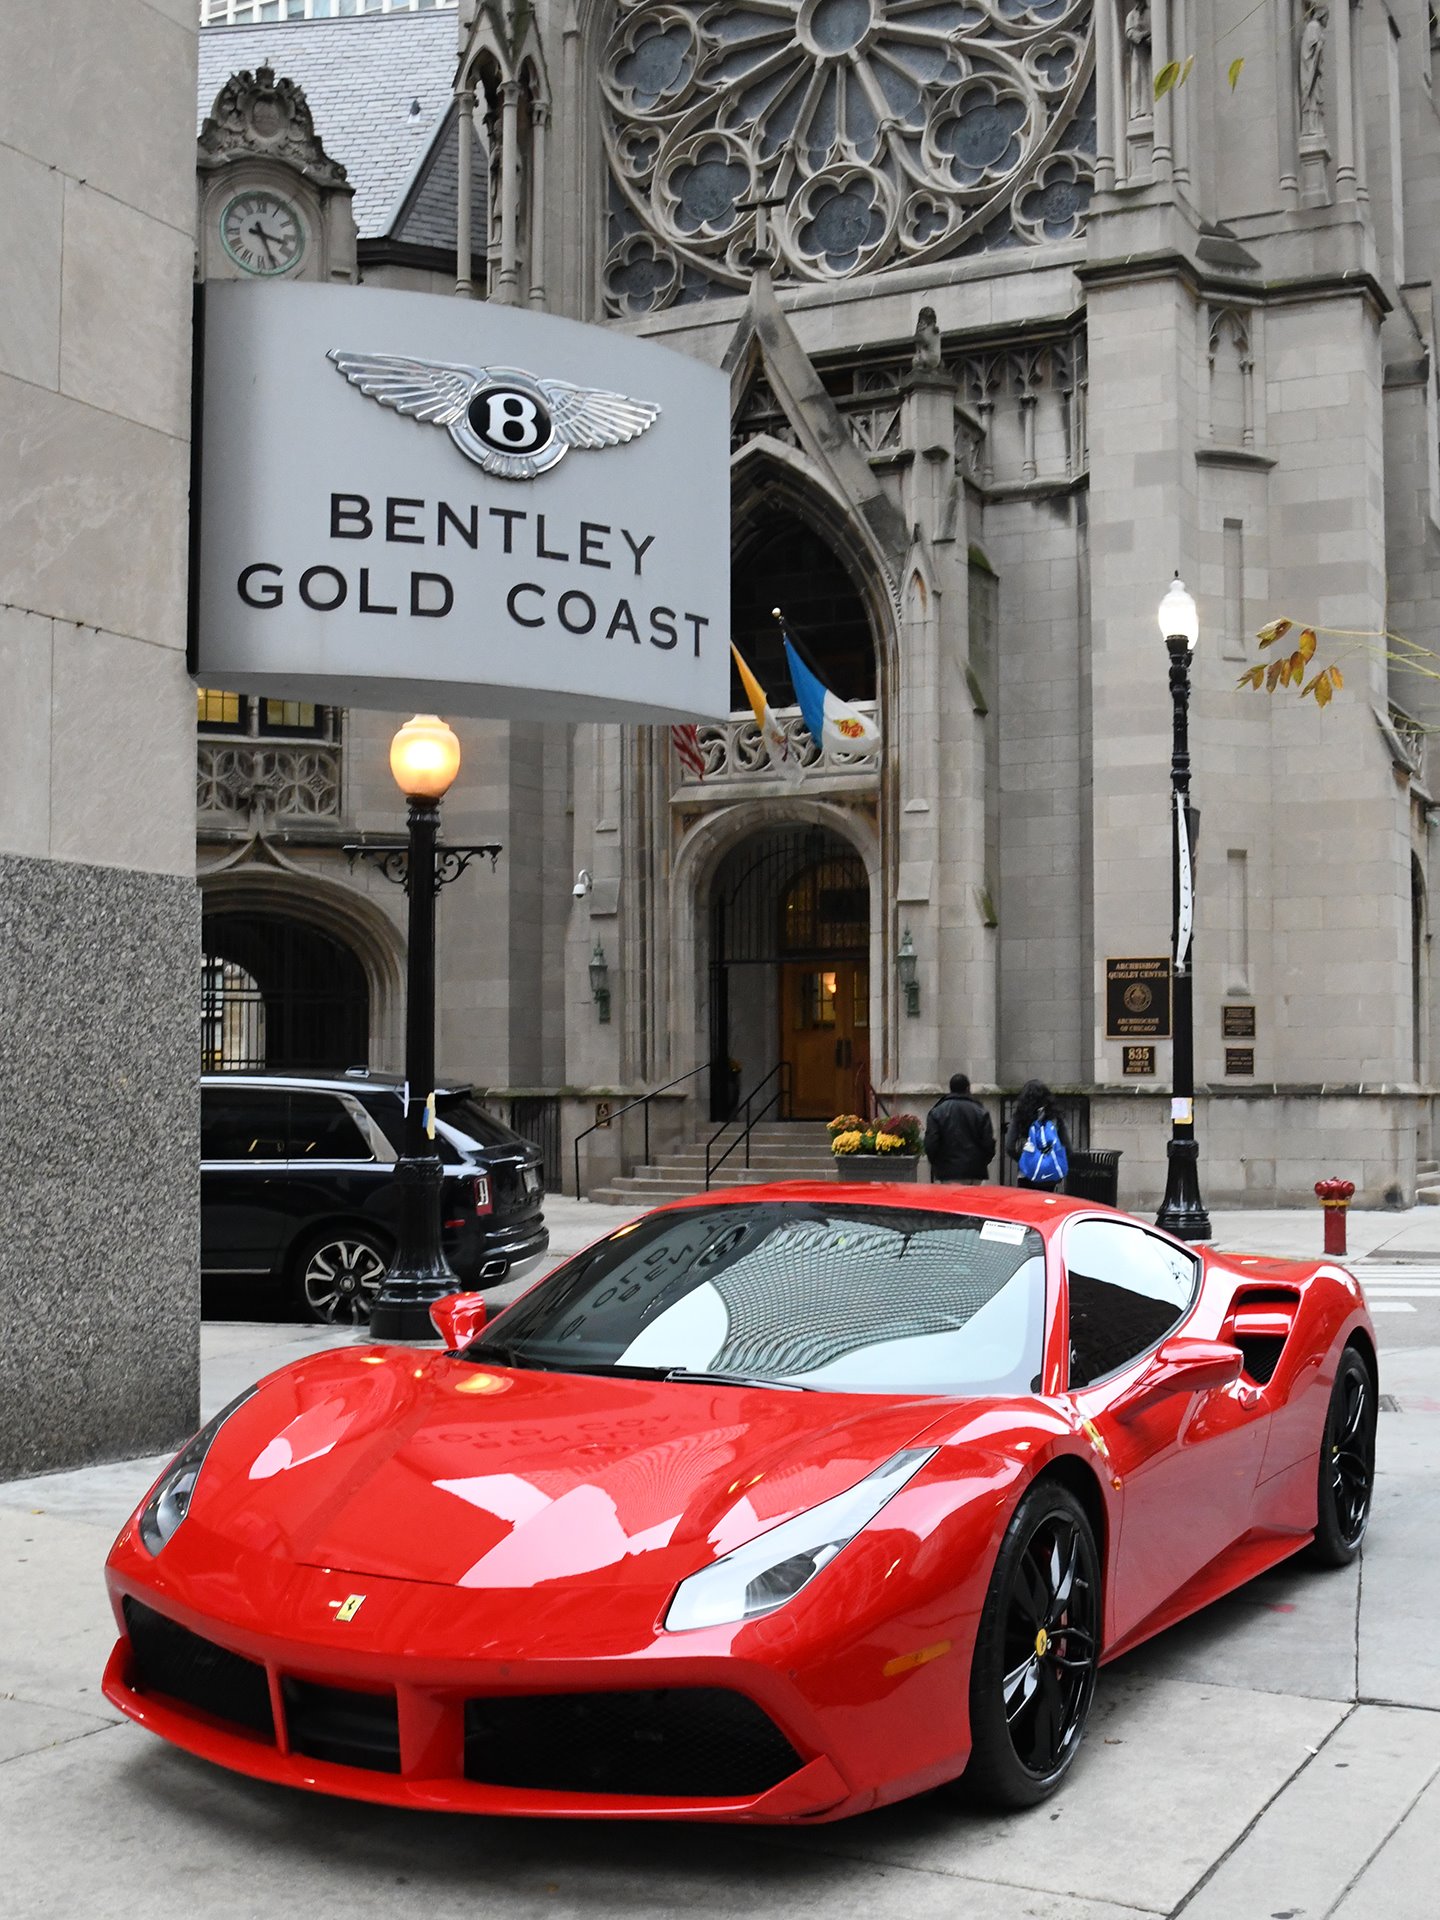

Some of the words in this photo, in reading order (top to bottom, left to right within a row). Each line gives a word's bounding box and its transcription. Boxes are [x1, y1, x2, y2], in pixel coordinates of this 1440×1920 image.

[486, 391, 538, 447] B
[330, 492, 656, 576] BENTLEY
[237, 562, 454, 618] GOLD
[506, 582, 710, 657] COAST
[1128, 1047, 1150, 1060] 835
